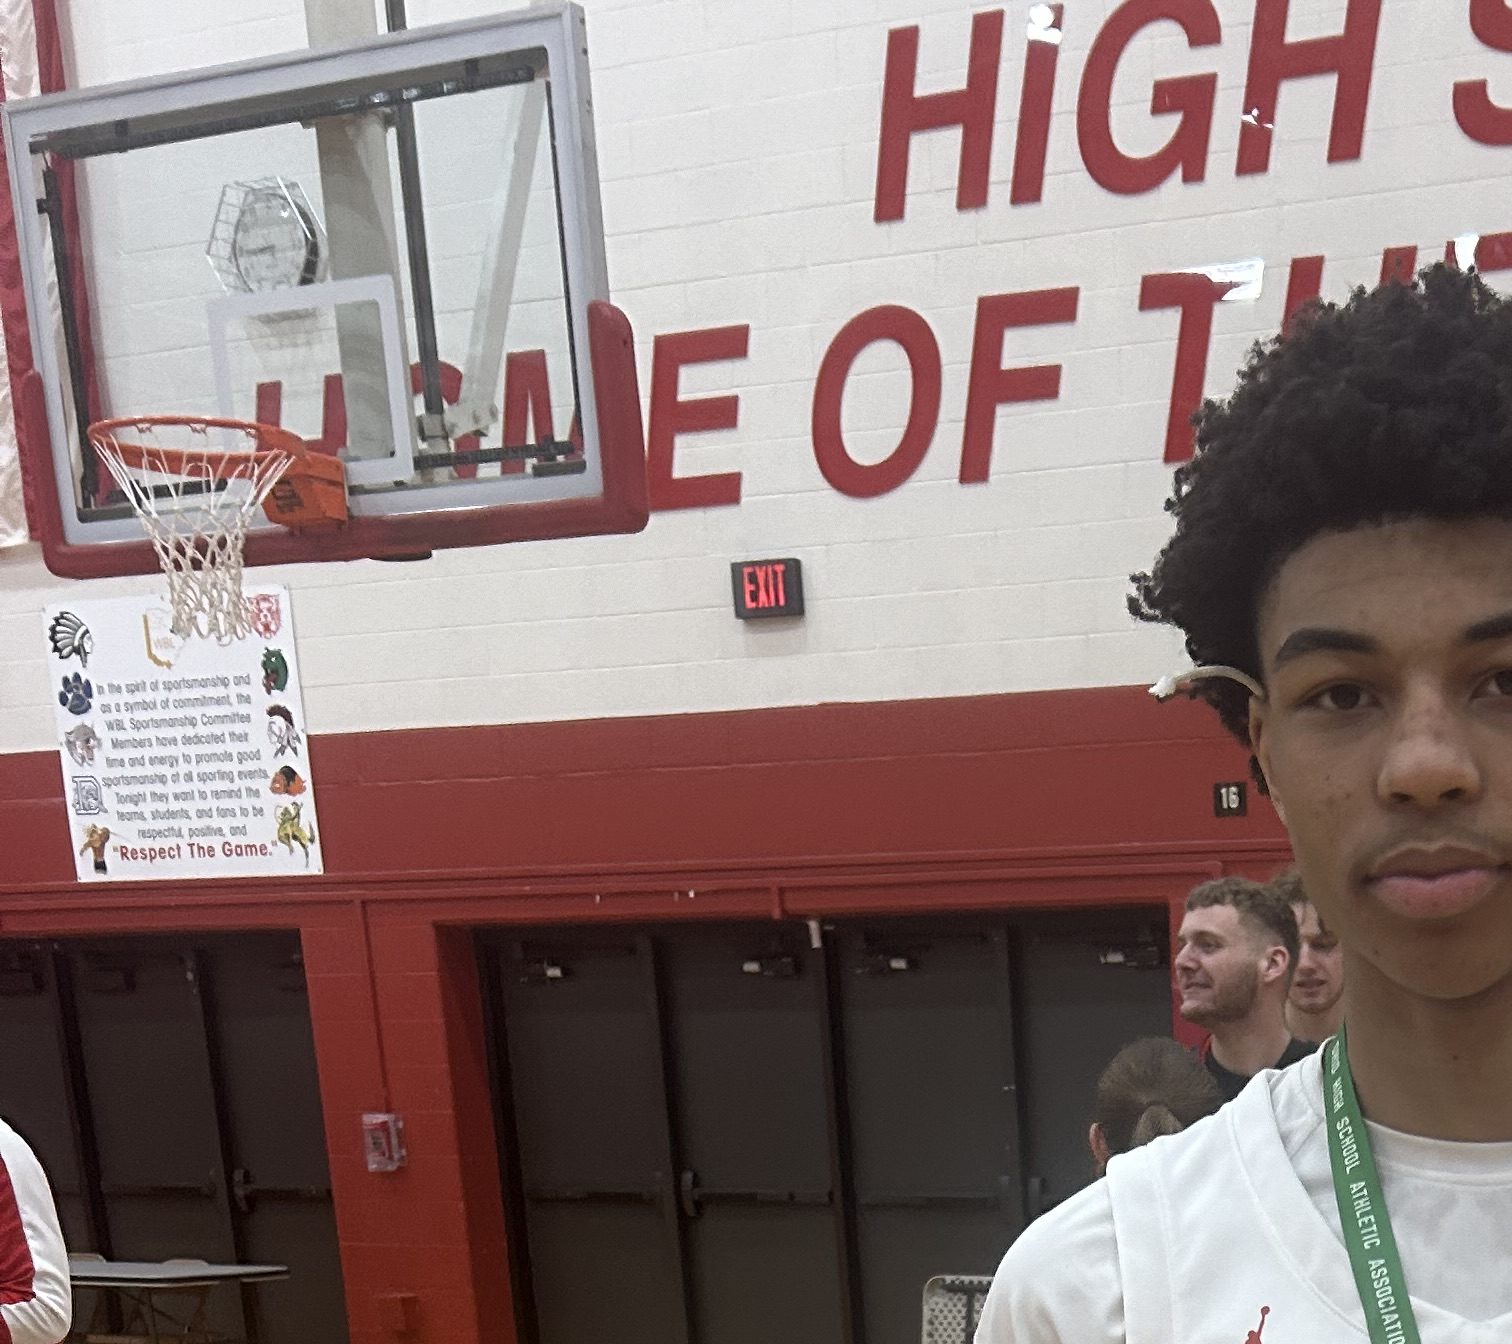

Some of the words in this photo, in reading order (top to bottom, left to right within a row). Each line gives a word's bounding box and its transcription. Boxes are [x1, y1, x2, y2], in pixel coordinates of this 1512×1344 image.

[874, 0, 1384, 223] HIGH
[811, 285, 1080, 499] OF
[742, 564, 786, 609] EXIT
[125, 680, 146, 695] spirit
[150, 680, 159, 692] of
[162, 675, 230, 692] sportsmanship
[233, 674, 251, 686] and
[124, 698, 157, 714] symbol
[160, 697, 169, 710] of
[236, 693, 251, 705] the
[104, 718, 127, 732] WBL
[129, 714, 197, 732] Sportsmanship
[201, 711, 252, 727] Committee
[111, 737, 153, 750] Members
[155, 735, 178, 747] have
[181, 732, 226, 746] dedicated
[228, 731, 249, 743] their
[128, 754, 145, 767] and
[148, 754, 179, 769] energy
[182, 752, 192, 765] to
[195, 750, 234, 766] promote
[237, 748, 261, 765] good
[102, 771, 168, 789] sportsmanship
[197, 769, 235, 785] sporting
[114, 791, 147, 807] Tonight
[150, 790, 169, 805] they
[172, 789, 195, 802] want
[197, 789, 208, 801] to
[211, 787, 242, 800] remind
[245, 785, 261, 799] the
[1219, 785, 1240, 809] 16
[196, 805, 214, 819] and
[216, 805, 238, 819] fans
[240, 805, 250, 818] to
[252, 804, 265, 818] be
[229, 823, 248, 837] and
[187, 842, 216, 859] The
[1336, 1115, 1362, 1175] SCHOOL
[1350, 1180, 1381, 1250] ATHLETIC
